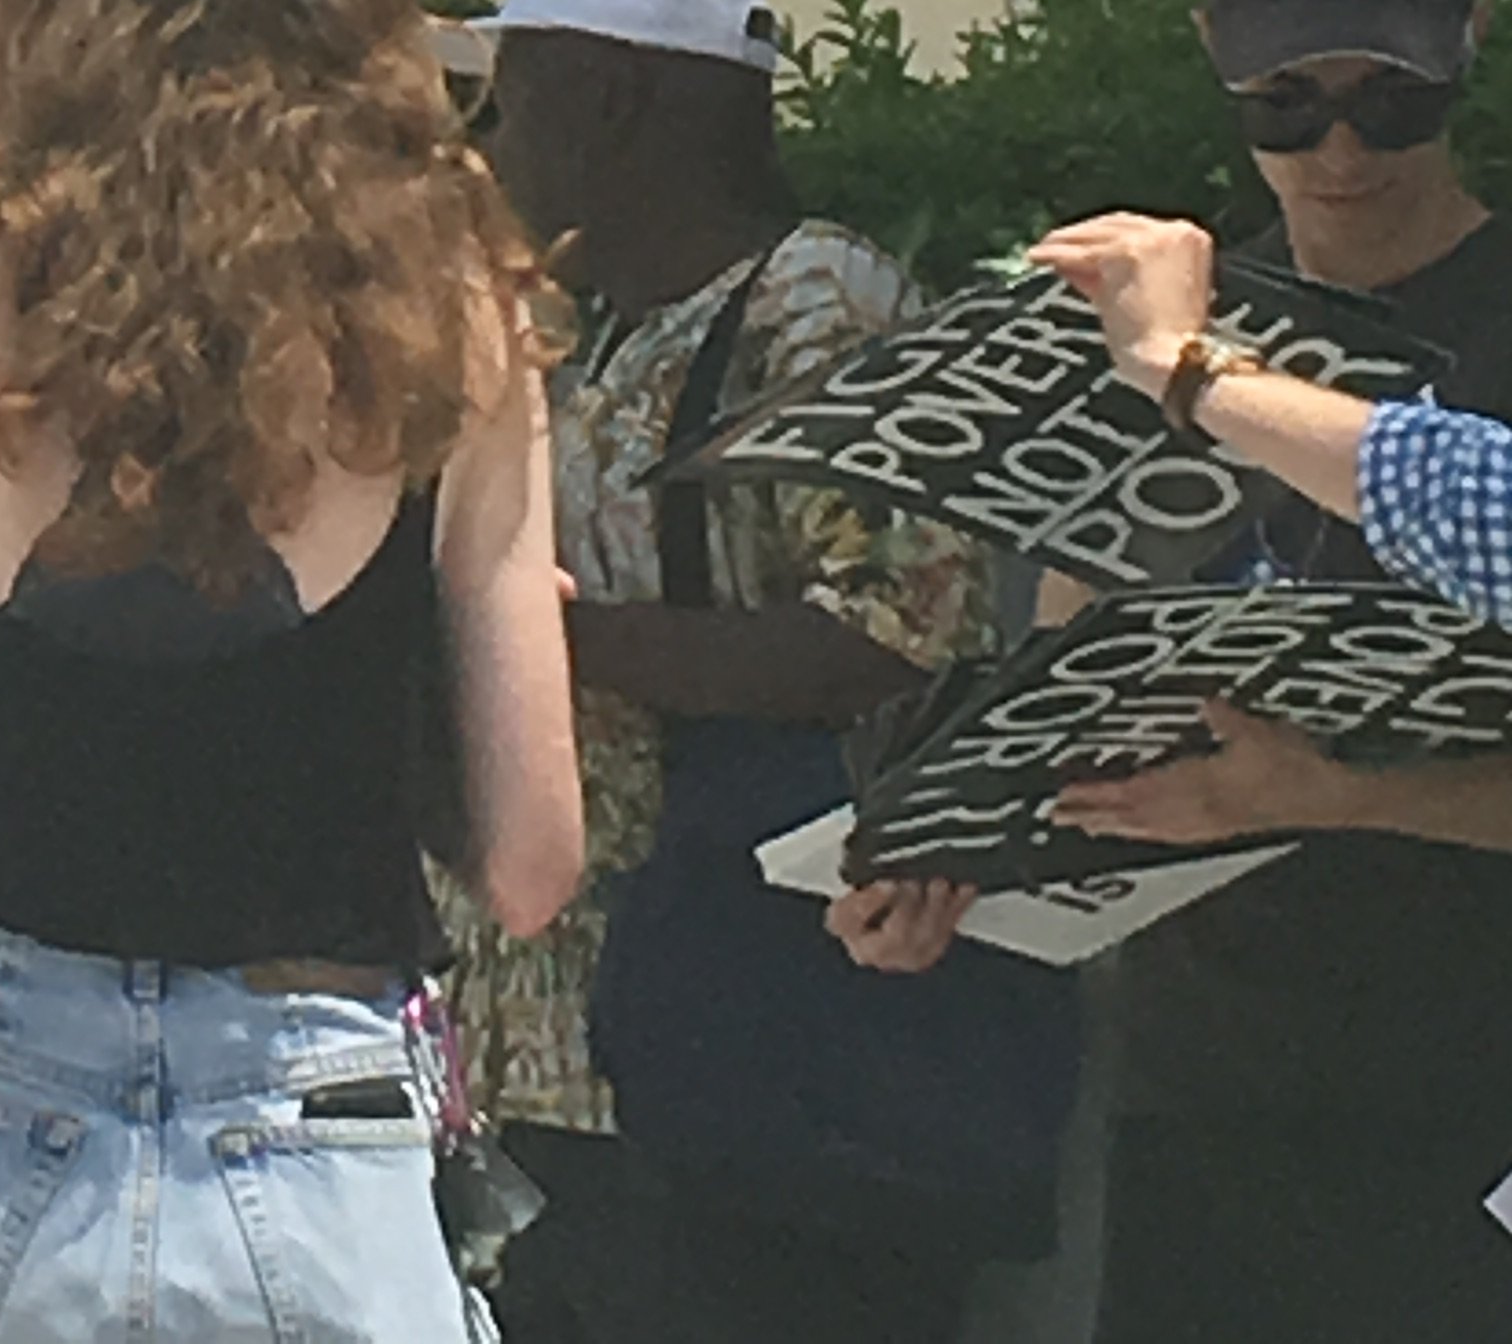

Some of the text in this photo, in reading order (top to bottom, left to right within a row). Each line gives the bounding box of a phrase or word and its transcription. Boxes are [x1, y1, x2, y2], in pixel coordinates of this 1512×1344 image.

[830, 279, 1108, 494] POVERT
[941, 394, 1150, 546] NOT
[918, 596, 1230, 776] POOR
